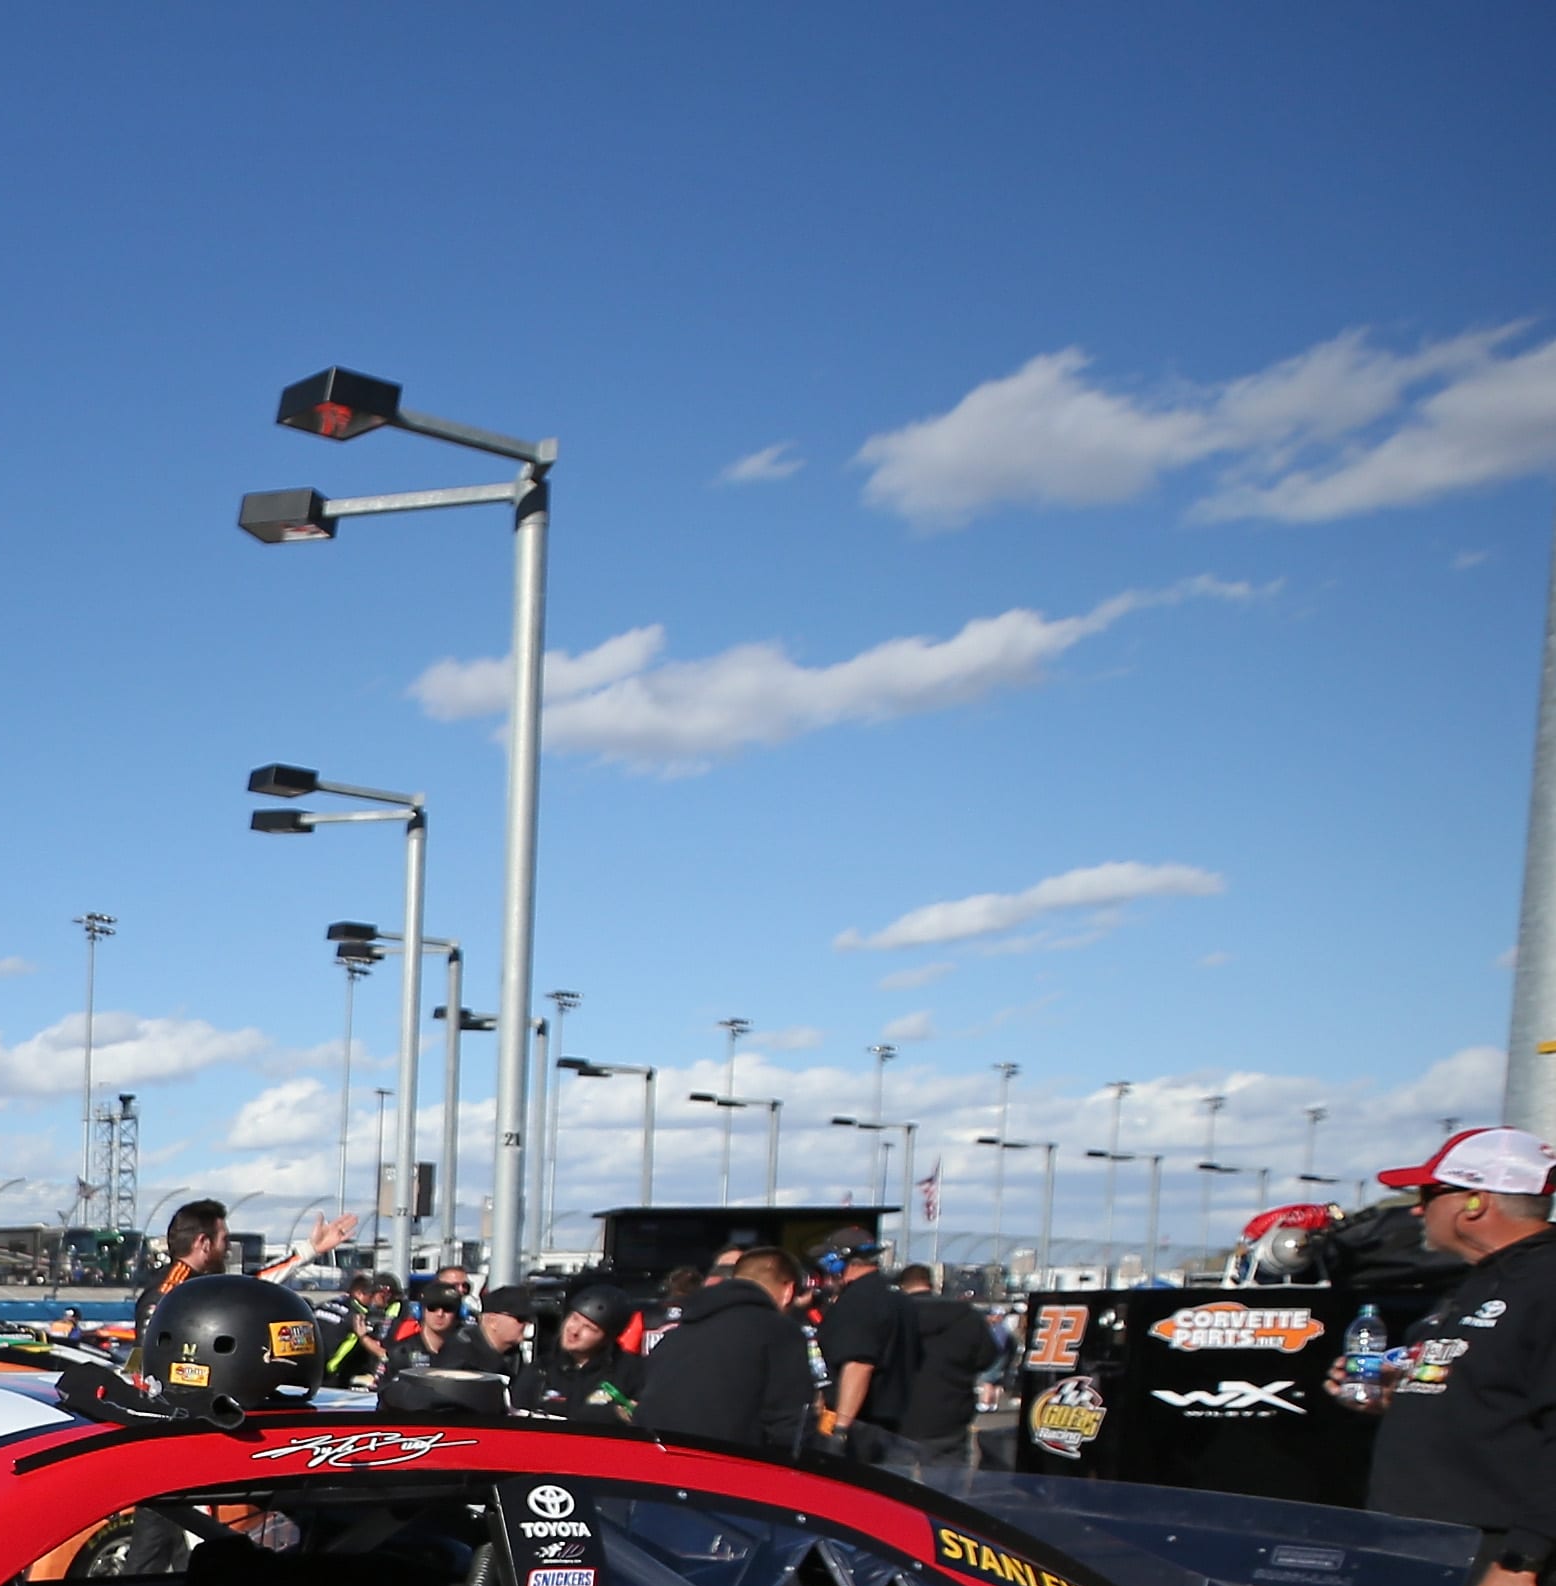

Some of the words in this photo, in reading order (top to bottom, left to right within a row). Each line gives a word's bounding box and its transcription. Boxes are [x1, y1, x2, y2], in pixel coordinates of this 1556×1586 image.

[1173, 1308, 1311, 1329] CORVETTE
[1026, 1305, 1089, 1368] 32
[1038, 1427, 1082, 1443] Racing
[519, 1521, 592, 1538] TOYOTA
